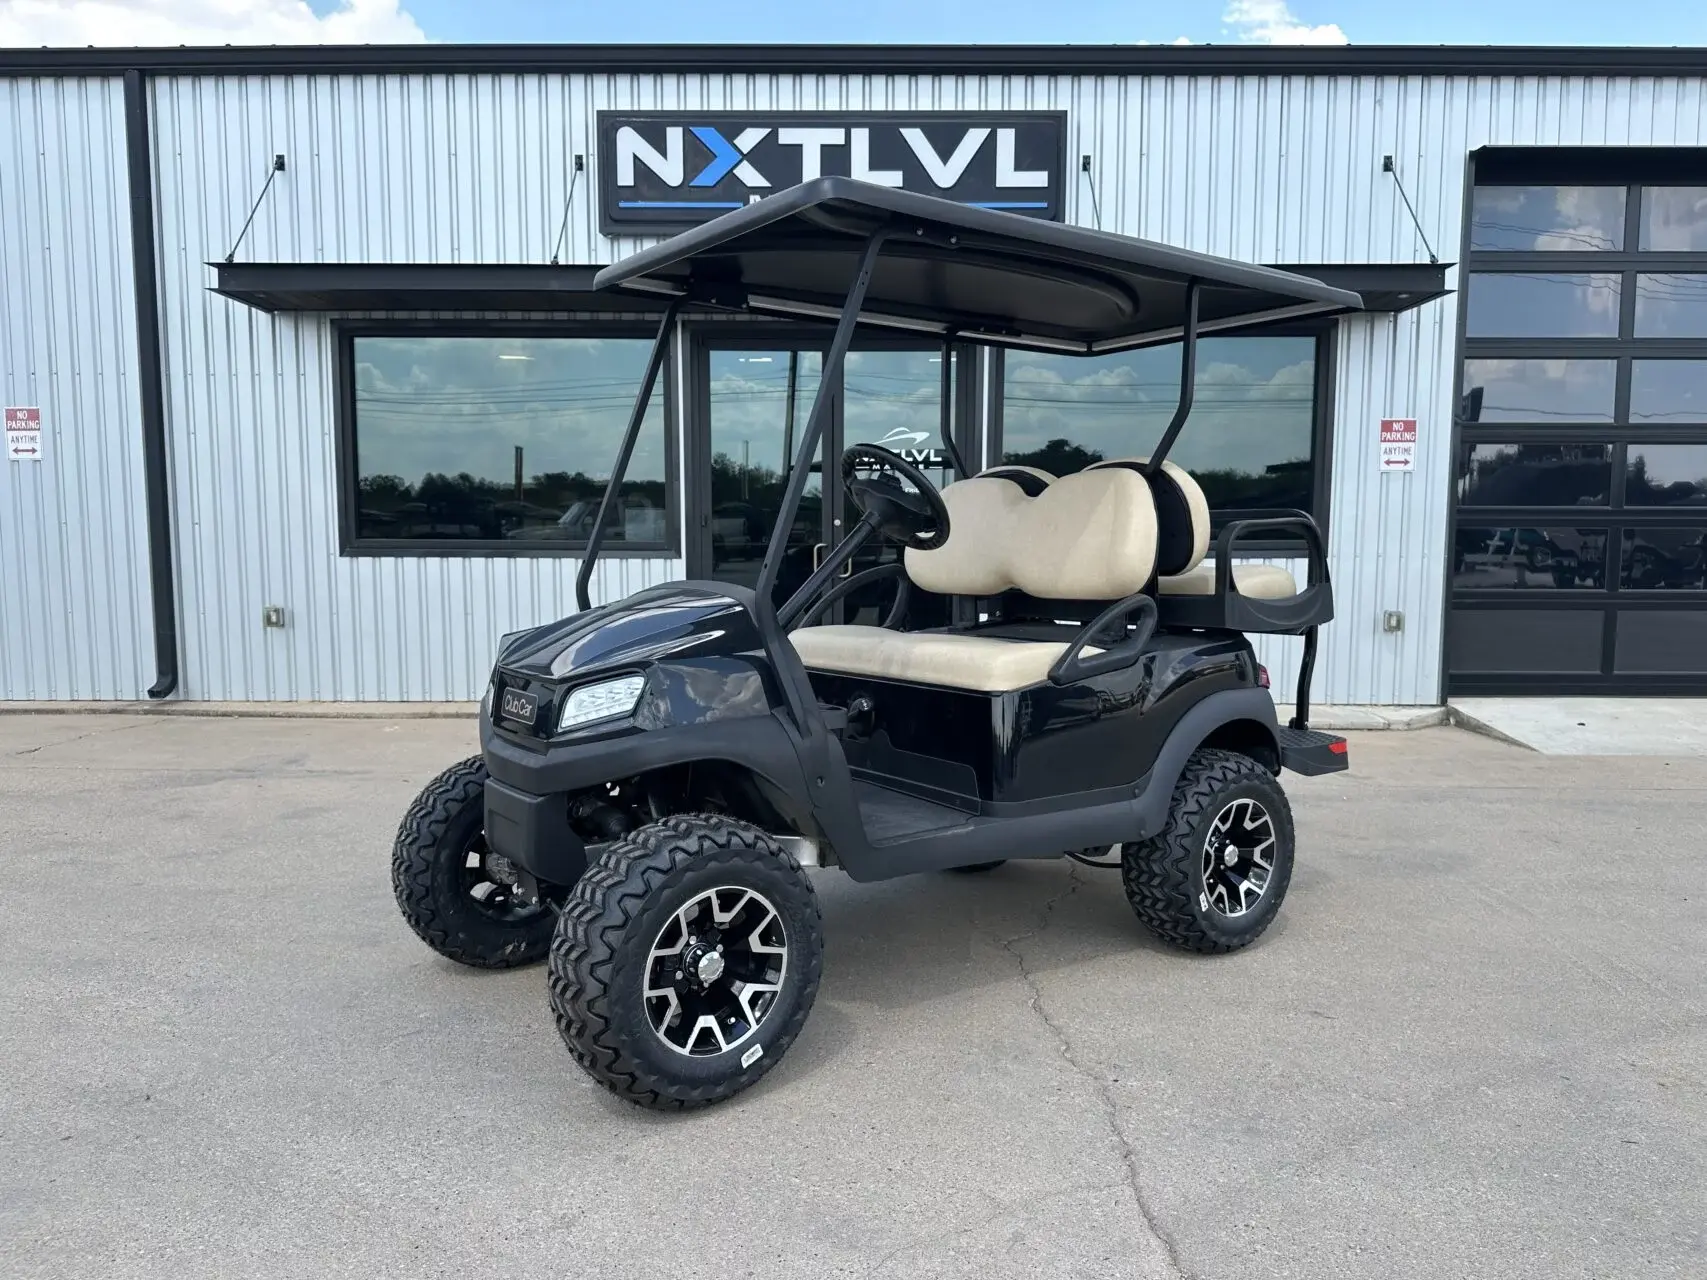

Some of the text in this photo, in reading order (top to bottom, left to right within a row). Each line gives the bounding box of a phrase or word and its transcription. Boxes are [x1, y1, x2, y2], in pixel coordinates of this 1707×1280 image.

[616, 126, 1048, 189] NXTLVL
[17, 410, 28, 420] NO
[7, 420, 40, 430] PARKING
[1392, 422, 1404, 431] NO
[11, 435, 39, 444] ANYTIME
[1381, 431, 1415, 441] PARKING
[1383, 446, 1412, 456] ANYTIME
